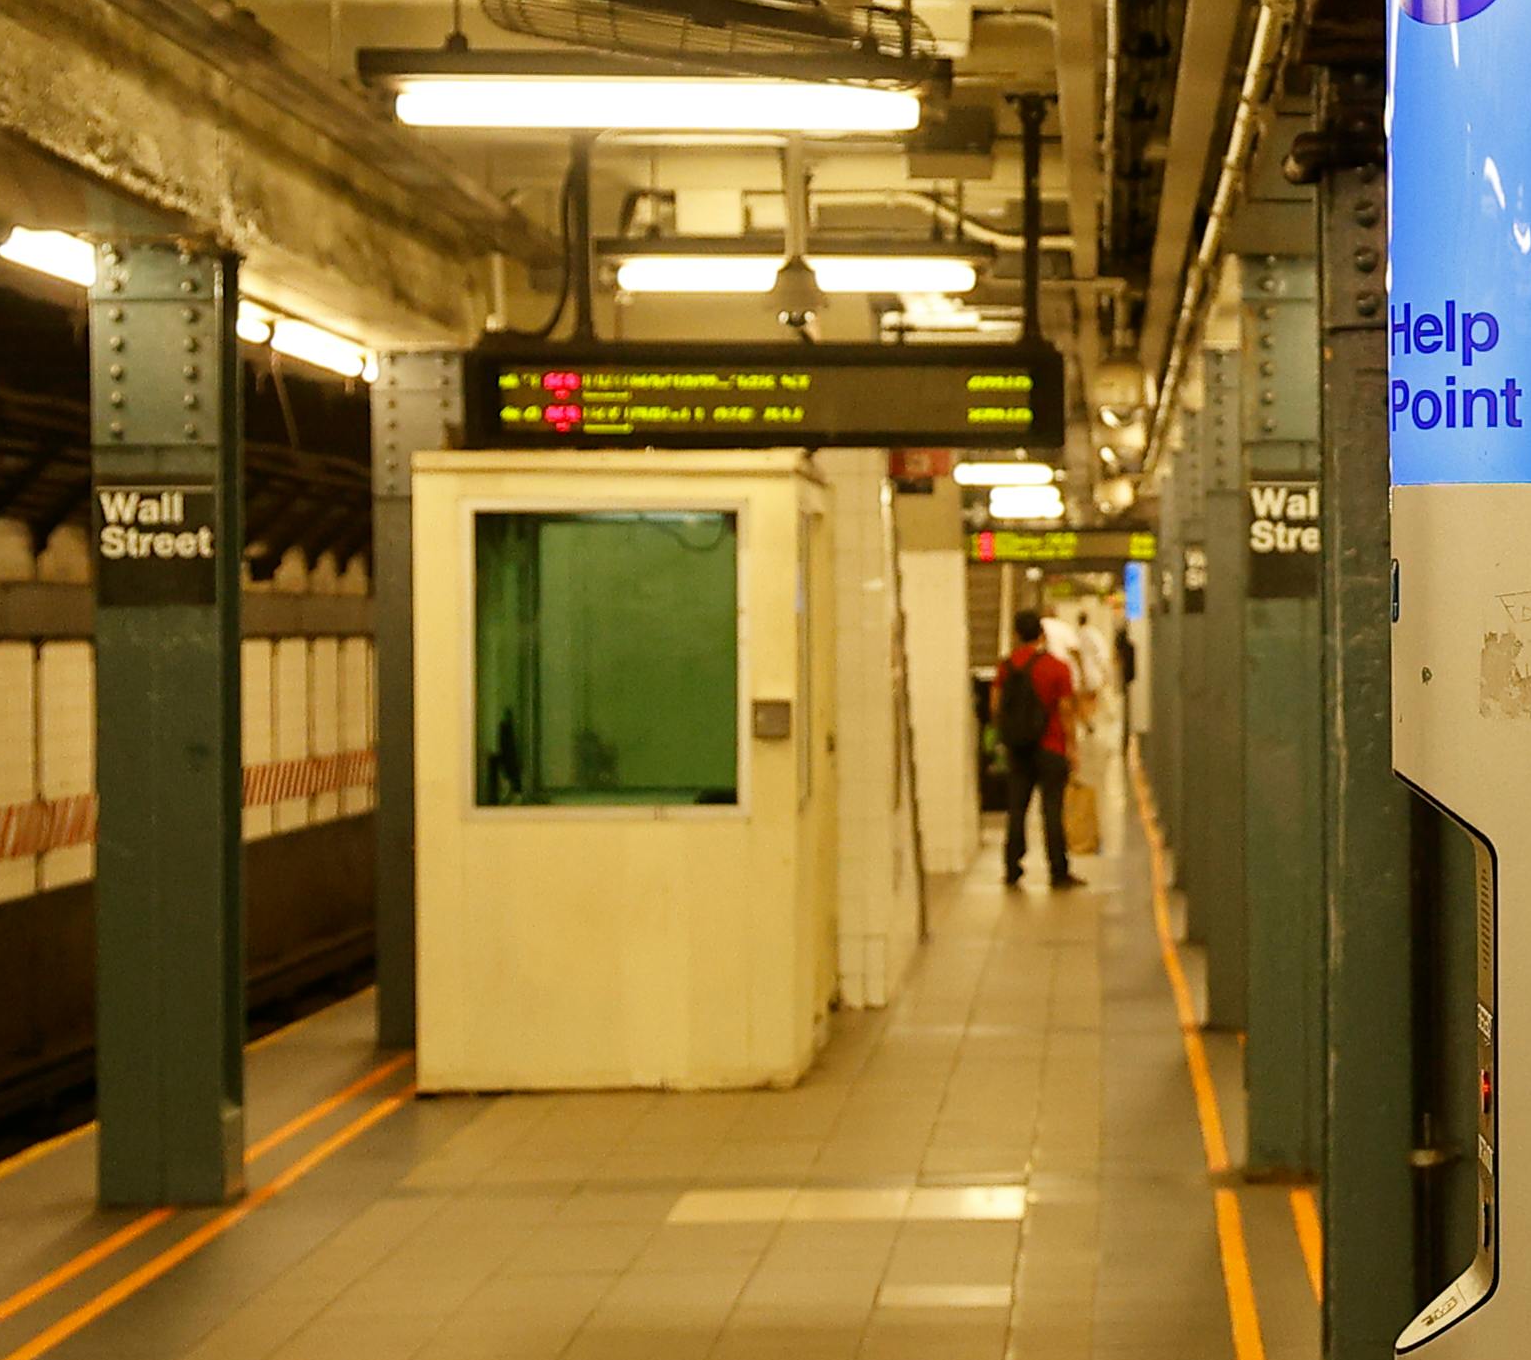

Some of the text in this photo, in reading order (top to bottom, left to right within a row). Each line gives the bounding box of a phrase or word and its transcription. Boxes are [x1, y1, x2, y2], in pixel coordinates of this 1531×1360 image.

[1391, 300, 1499, 366] Help
[1392, 376, 1522, 431] Point
[99, 491, 185, 525] Wall
[1250, 487, 1319, 519] Wal
[99, 524, 214, 559] Street
[1250, 520, 1321, 553] Stre
